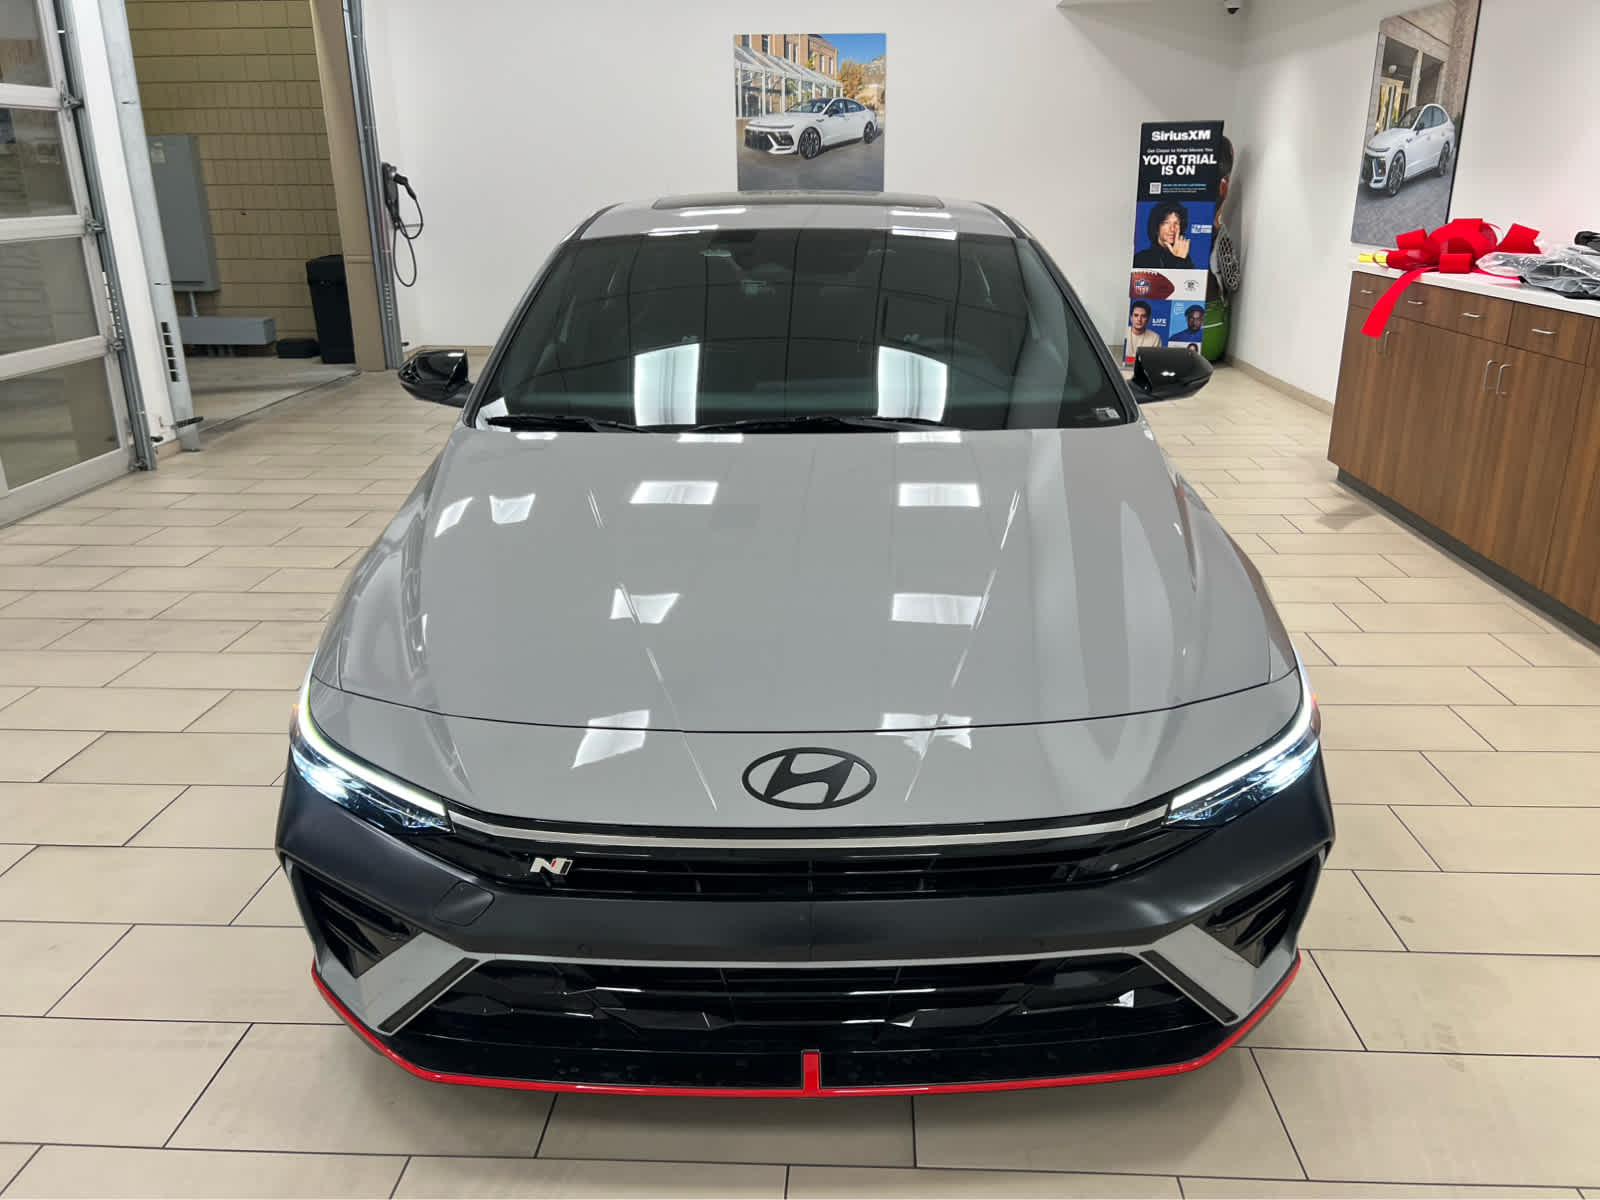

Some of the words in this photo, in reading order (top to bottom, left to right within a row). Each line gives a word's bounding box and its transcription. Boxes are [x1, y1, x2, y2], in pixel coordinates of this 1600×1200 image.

[1151, 130, 1211, 141] SiriusXM
[1142, 154, 1178, 165] YOUR
[1180, 153, 1217, 165] TRIAL
[1161, 165, 1174, 176] IS
[1176, 165, 1196, 176] ON
